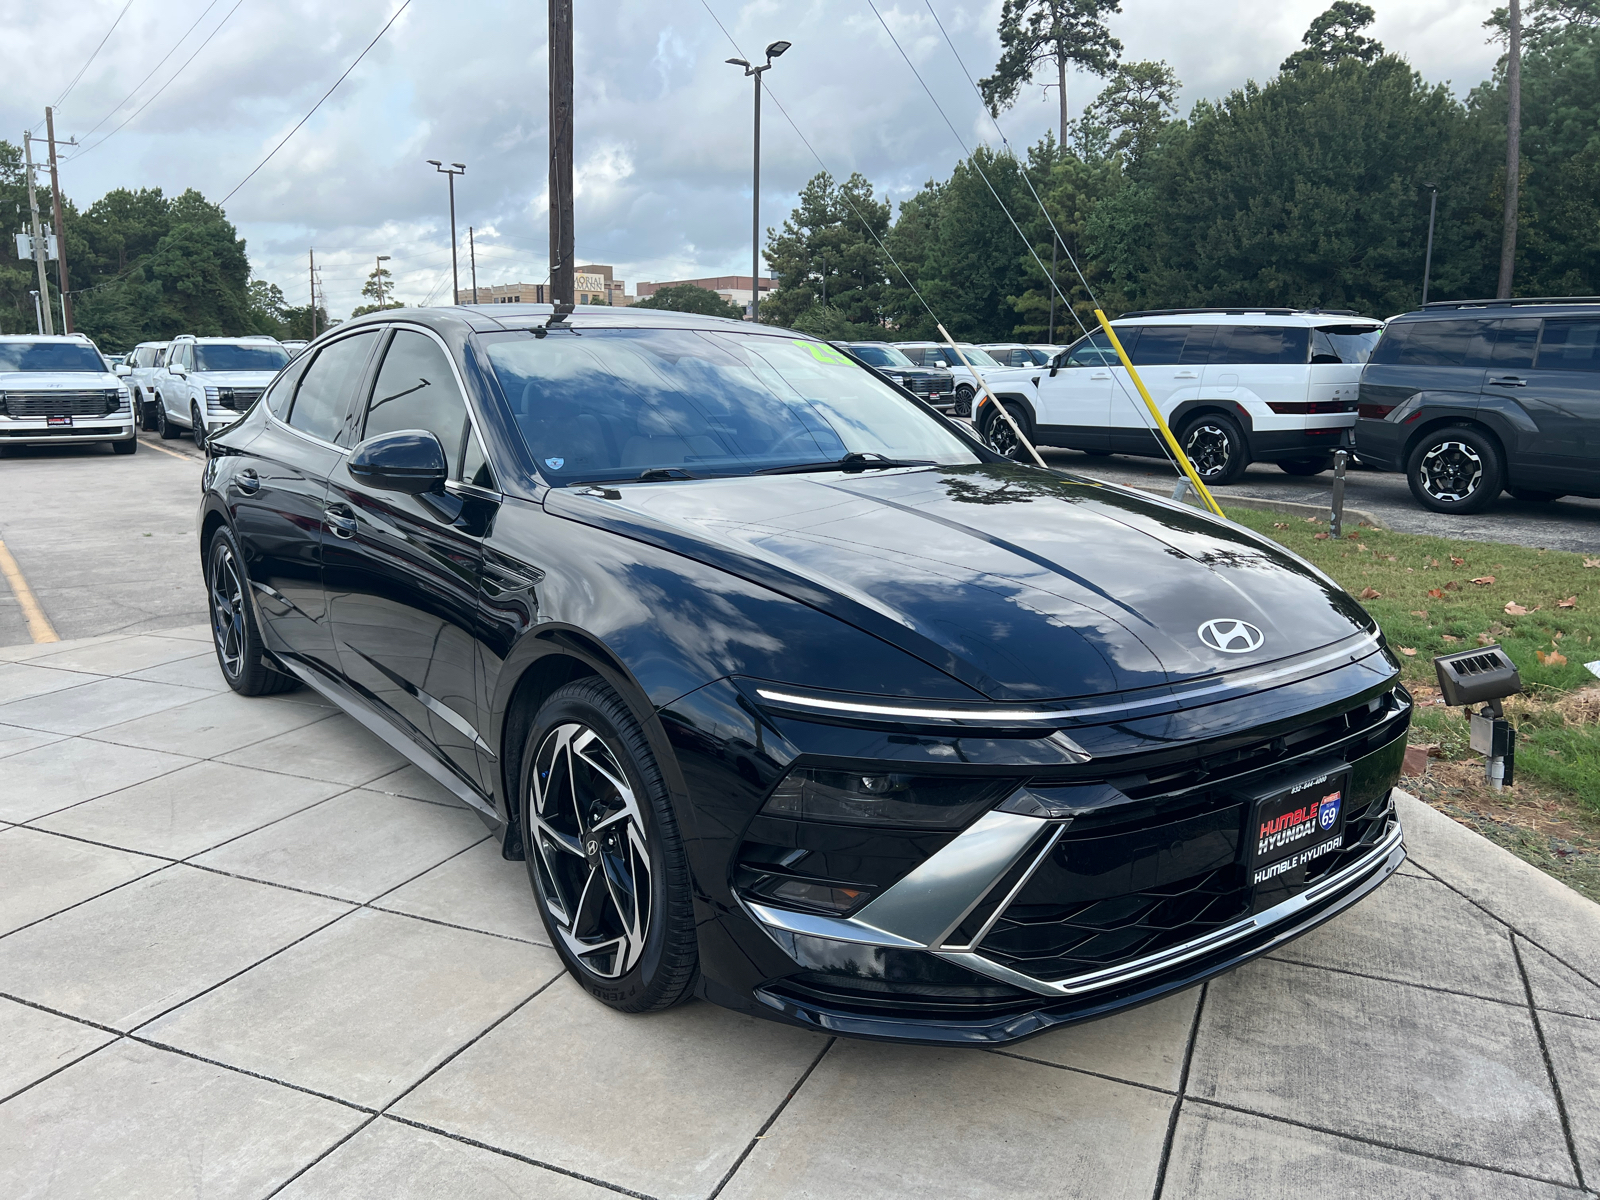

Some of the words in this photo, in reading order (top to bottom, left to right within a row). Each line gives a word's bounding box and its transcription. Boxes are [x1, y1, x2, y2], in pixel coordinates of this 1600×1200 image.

[574, 282, 602, 291] MANN
[792, 340, 858, 367] 25
[1259, 801, 1319, 839] HUMBLE
[1321, 807, 1336, 826] 69
[1257, 818, 1317, 855] HYUNDAI
[1254, 856, 1298, 884] HUMBLE
[1300, 836, 1342, 865] HYUNDAI
[593, 988, 626, 1002] ZERO
